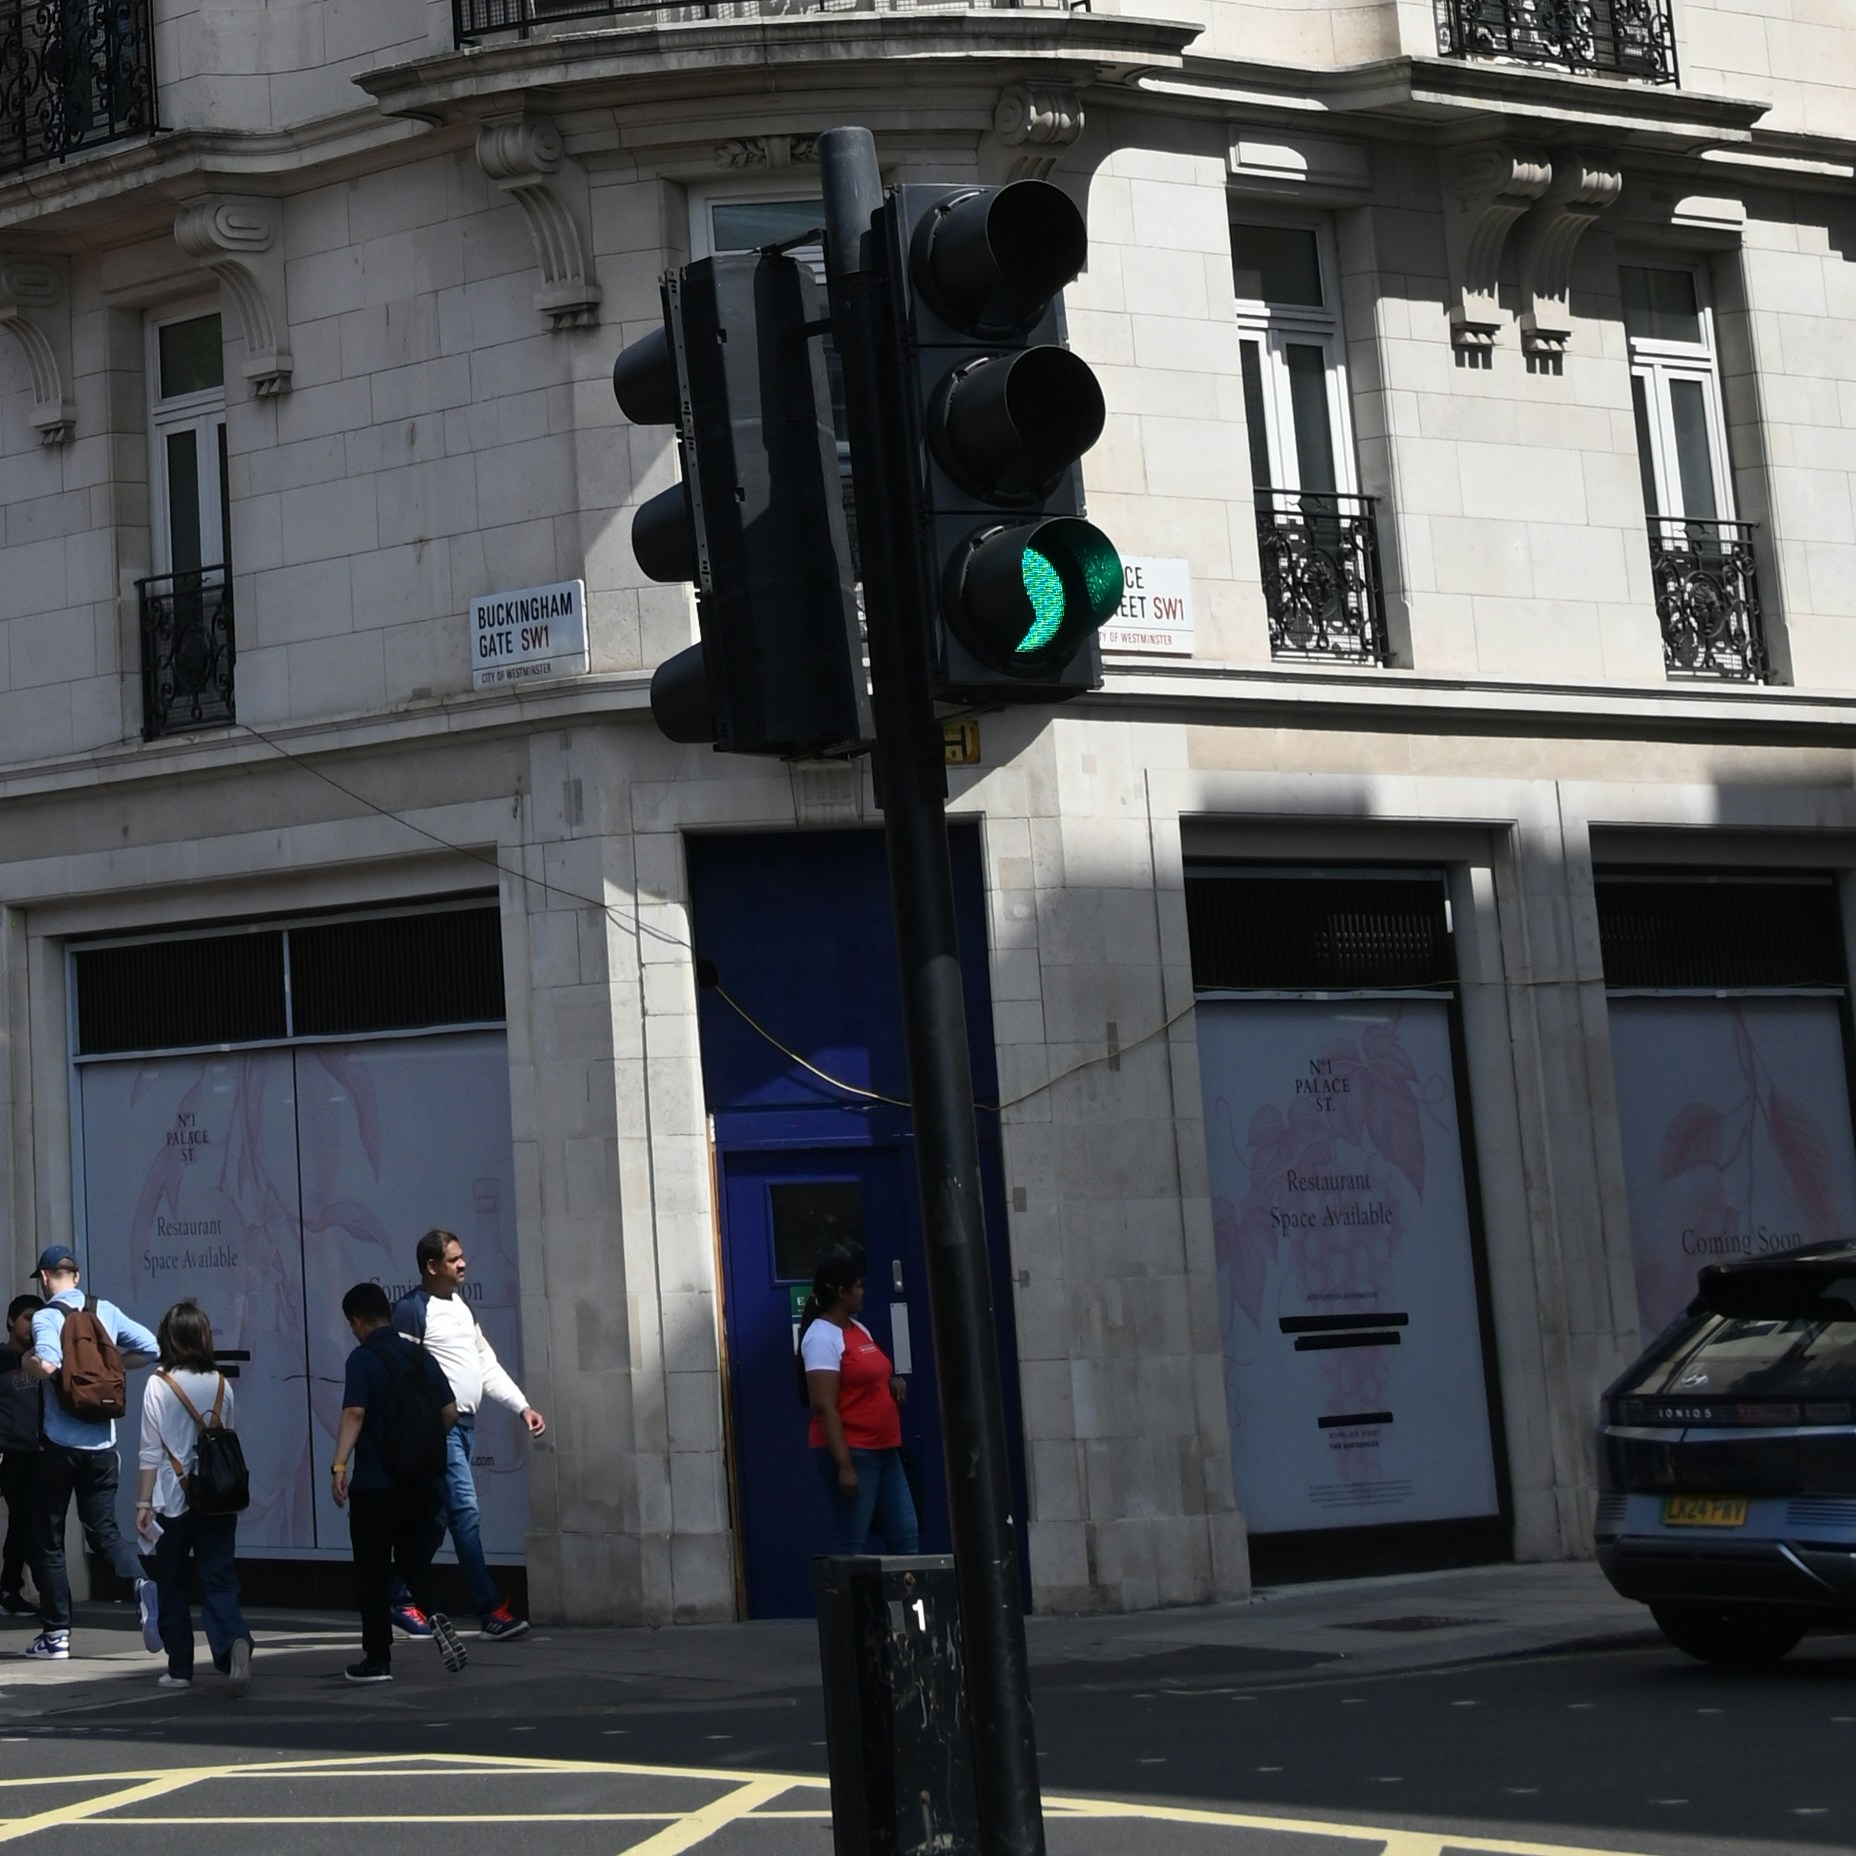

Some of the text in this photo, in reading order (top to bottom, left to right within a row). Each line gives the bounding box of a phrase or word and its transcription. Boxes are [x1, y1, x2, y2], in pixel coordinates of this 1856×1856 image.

[478, 592, 572, 629] BUCKINGHAM
[1153, 596, 1184, 621] SW1
[479, 625, 549, 658] GATE SW1
[1110, 631, 1119, 642] OF
[1121, 632, 1172, 645] WESTMINSTER
[481, 663, 552, 684] CITY OF WESTMINSTER
[1295, 1078, 1351, 1095] PALACE
[166, 1130, 209, 1145] PALACE
[1286, 1170, 1371, 1192] Restaurant
[157, 1217, 222, 1236] Restaurant
[1270, 1202, 1393, 1237] Space Available
[1682, 1226, 1801, 1256] Coming Soon
[143, 1245, 238, 1278] Space Available
